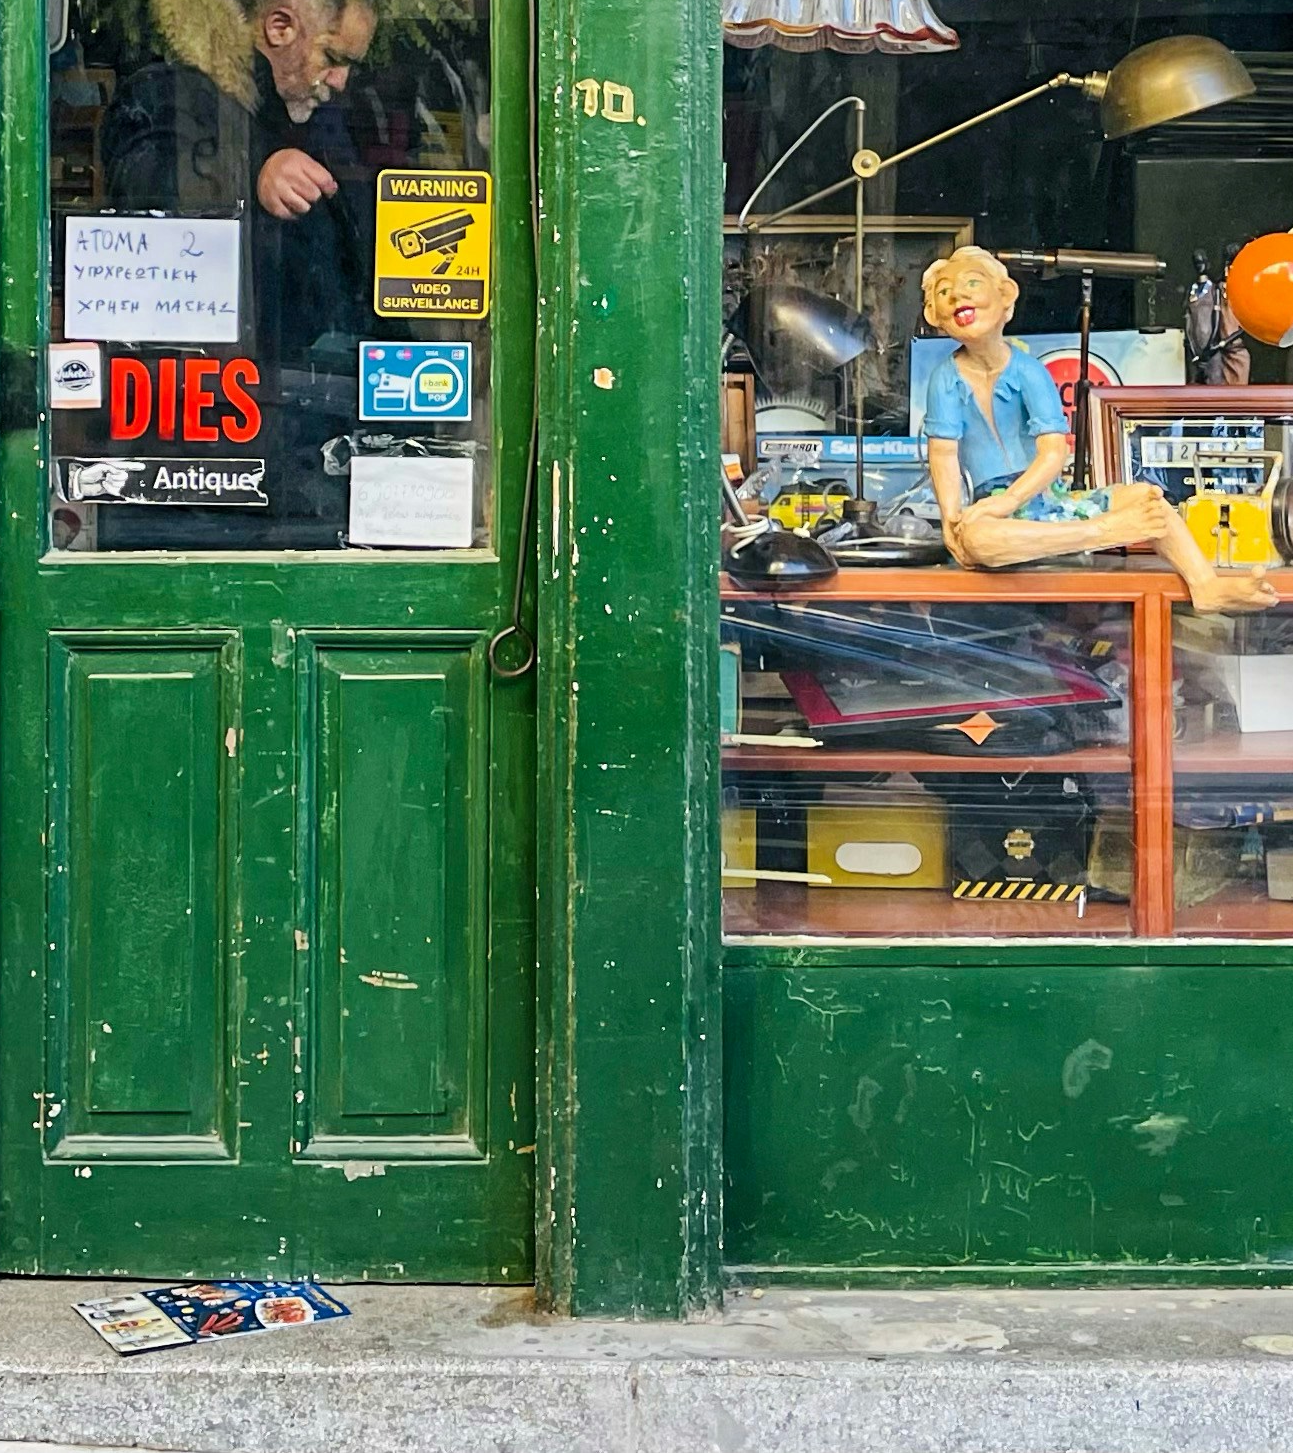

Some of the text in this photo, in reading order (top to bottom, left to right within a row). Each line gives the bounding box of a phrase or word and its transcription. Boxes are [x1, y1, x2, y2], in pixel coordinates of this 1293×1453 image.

[390, 179, 478, 198] WARNING
[77, 229, 204, 257] ΑΤΟΜΑ 2
[456, 266, 480, 276] 24H
[411, 283, 451, 294] VIDEO
[383, 297, 479, 310] SURVEILLANCE
[110, 357, 262, 443] DIES
